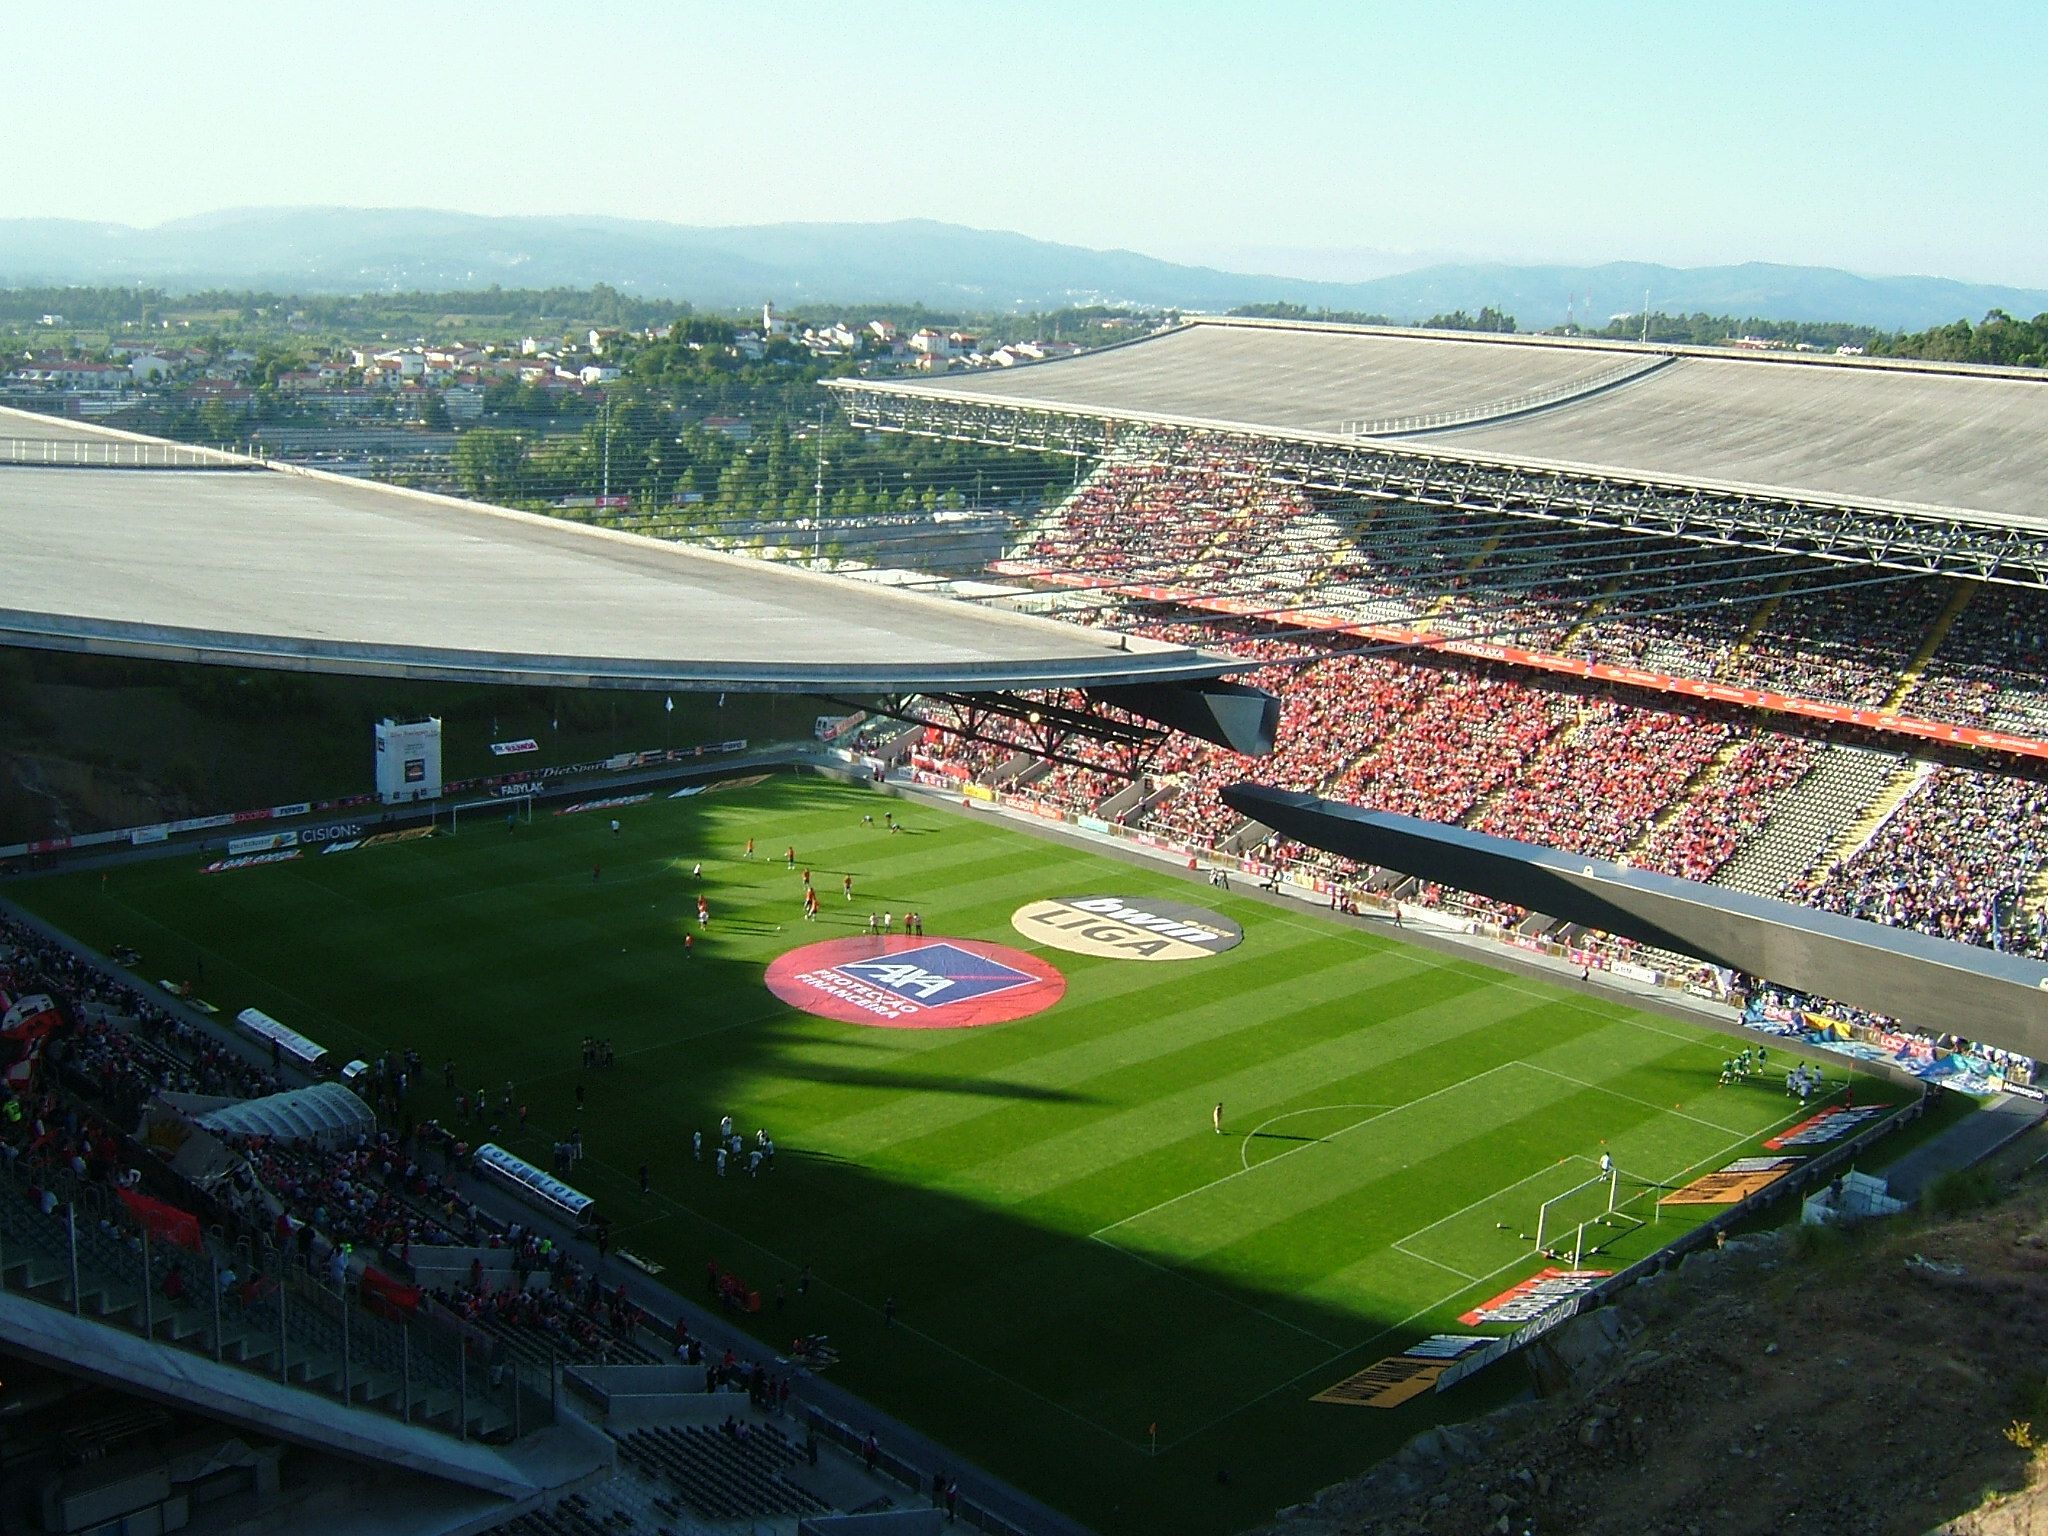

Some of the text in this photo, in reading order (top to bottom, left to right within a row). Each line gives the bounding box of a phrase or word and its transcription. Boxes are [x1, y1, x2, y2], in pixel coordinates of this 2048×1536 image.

[302, 827, 350, 843] CISION
[1028, 909, 1170, 956] LIGA
[1070, 898, 1218, 943] bwin
[794, 974, 901, 1019] FINANCEIRA
[844, 964, 955, 998] AXA
